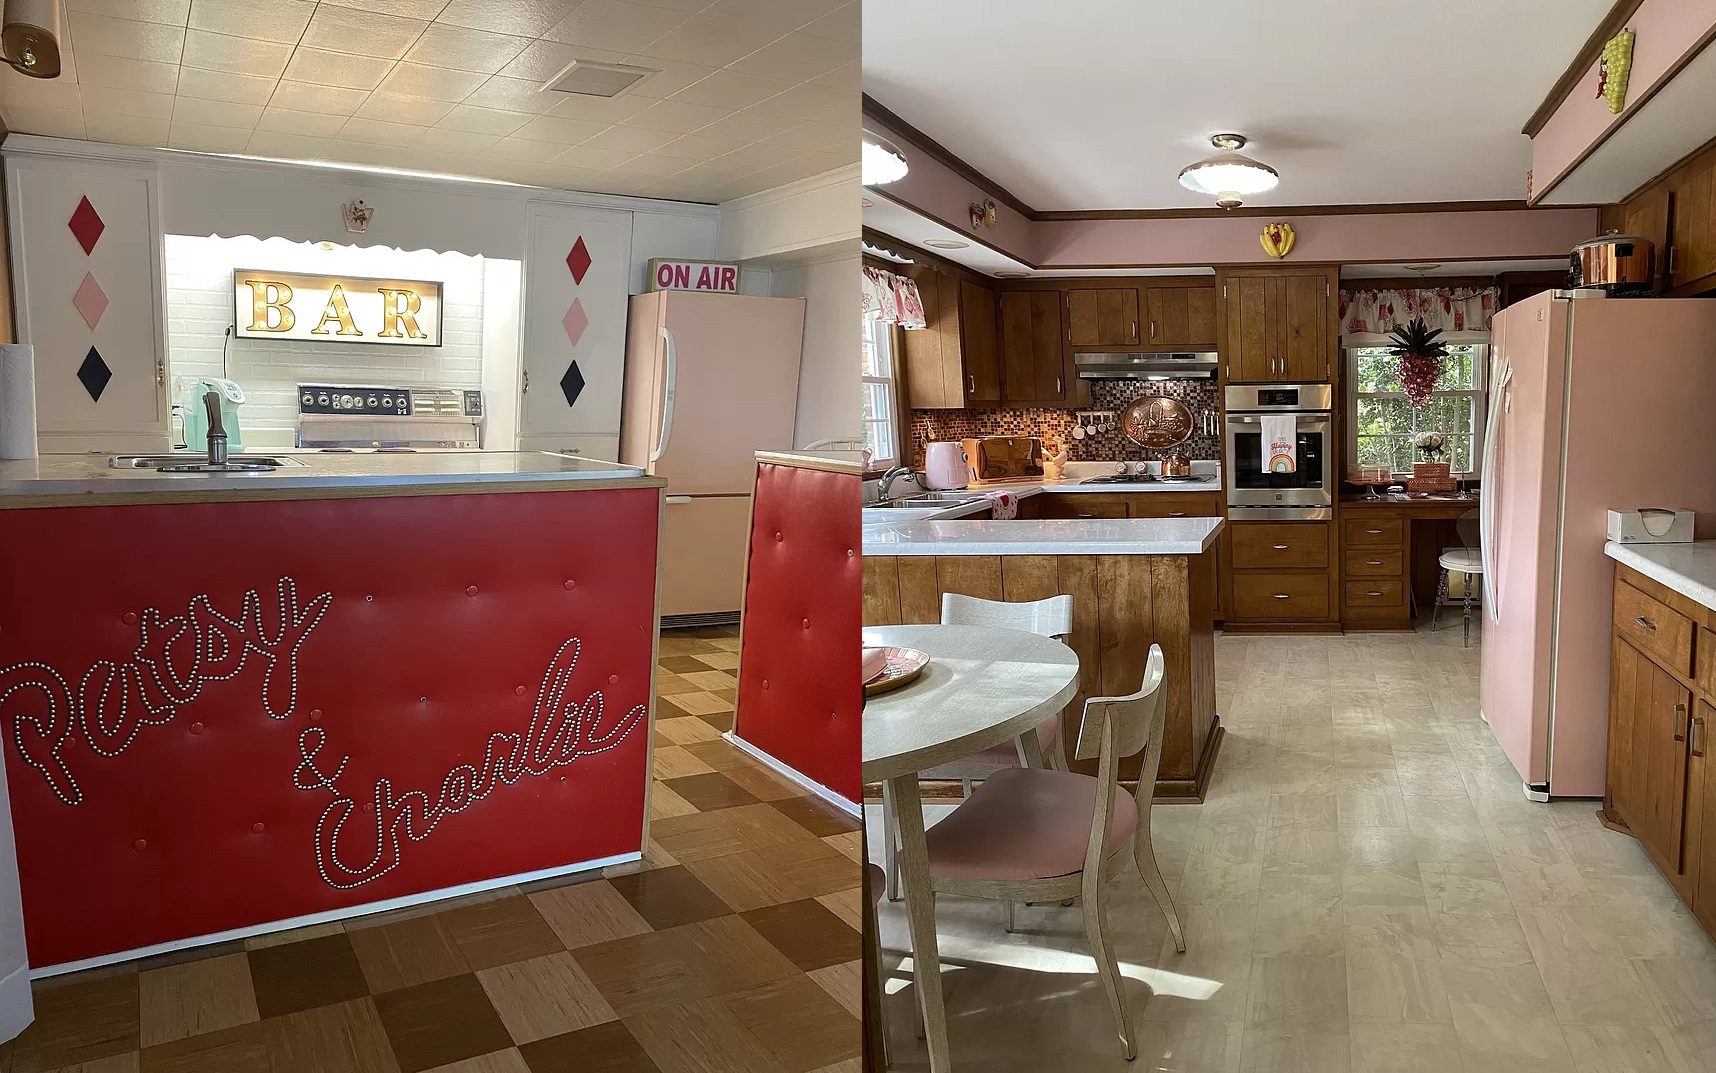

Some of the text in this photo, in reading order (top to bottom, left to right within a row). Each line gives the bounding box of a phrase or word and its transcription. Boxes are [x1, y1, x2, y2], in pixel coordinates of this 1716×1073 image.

[244, 280, 428, 339] BAR
[657, 263, 736, 291] ON AIR
[0, 575, 333, 806] Patsy
[292, 726, 350, 798] &
[314, 636, 647, 890] Charlie
